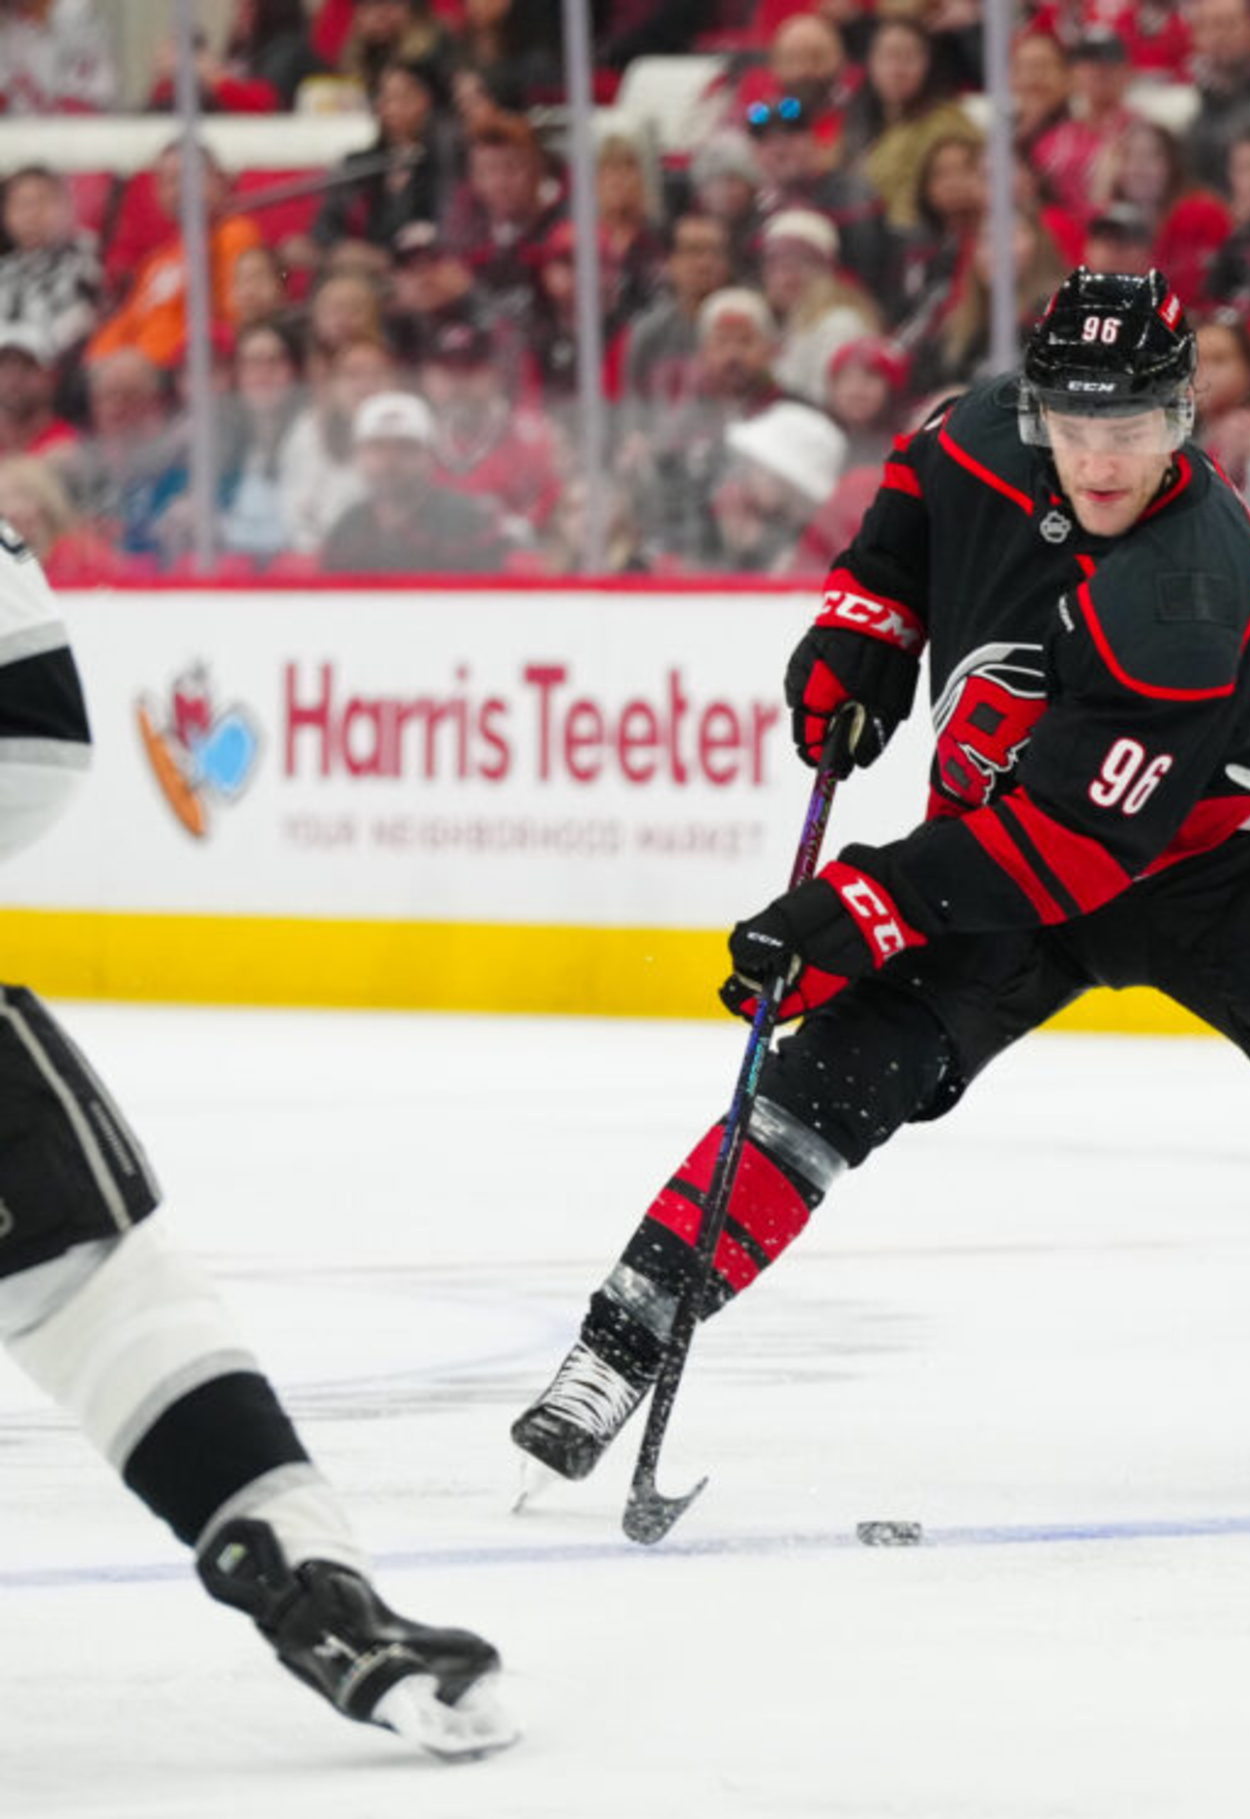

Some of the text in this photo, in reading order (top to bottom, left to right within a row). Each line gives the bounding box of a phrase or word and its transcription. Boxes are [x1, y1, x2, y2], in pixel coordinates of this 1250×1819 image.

[1082, 316, 1122, 343] 96
[1067, 380, 1117, 392] CCM
[822, 589, 920, 650] CCM
[284, 663, 780, 786] Harris Teeter
[1088, 737, 1174, 815] 96
[285, 817, 765, 857] YOUR NEIGHBORHOOD MARKET
[746, 930, 785, 949] CCM
[841, 877, 906, 960] CC
